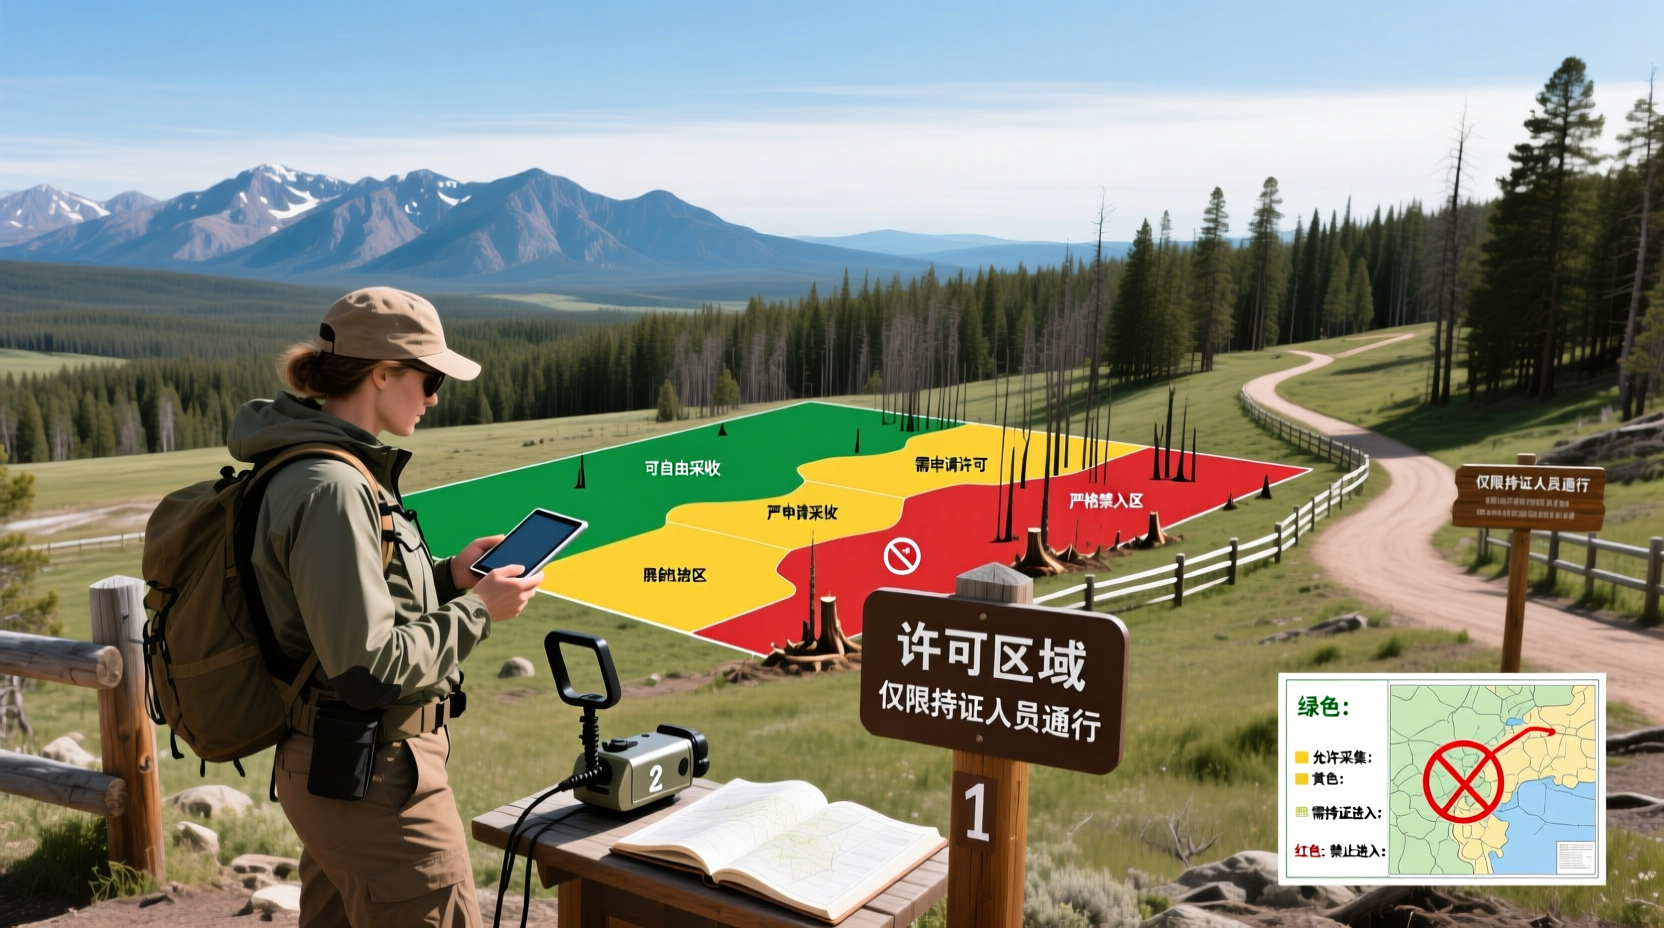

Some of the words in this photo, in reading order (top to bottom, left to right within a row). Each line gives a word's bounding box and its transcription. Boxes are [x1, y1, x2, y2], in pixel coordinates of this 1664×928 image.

[897, 621, 1087, 692] 许可区域
[879, 680, 1101, 742] 仅限持证人员通行
[649, 765, 663, 793] 2
[965, 783, 990, 842] 1
